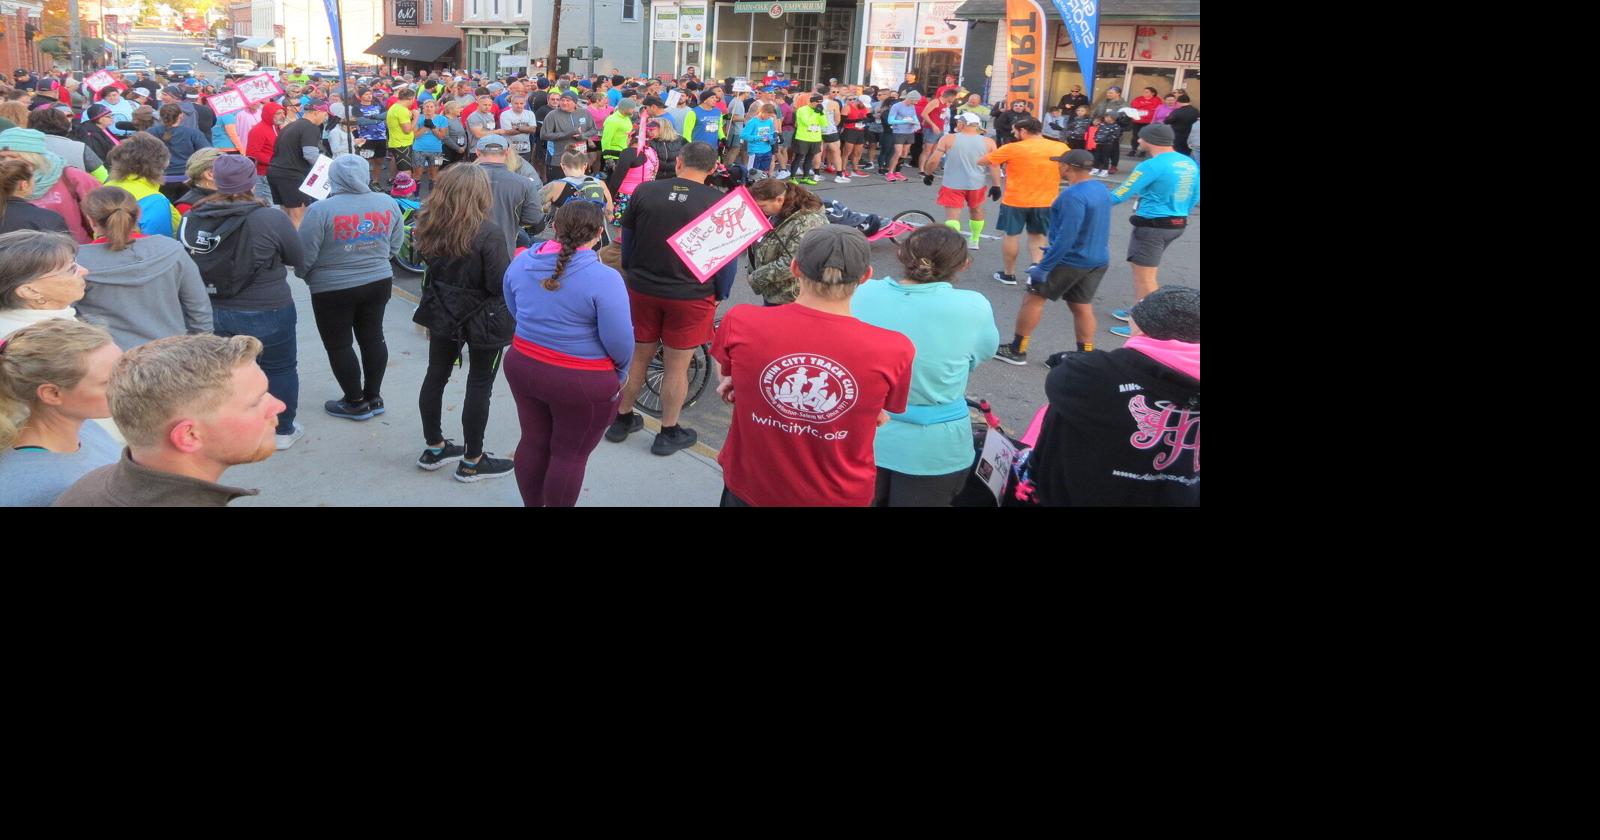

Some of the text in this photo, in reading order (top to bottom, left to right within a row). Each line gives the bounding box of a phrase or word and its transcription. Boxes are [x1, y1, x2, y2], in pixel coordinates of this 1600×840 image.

[679, 226, 702, 249] Team
[686, 225, 716, 256] Kylee
[763, 356, 855, 400] TWIN CITY TRACK CLUB
[751, 411, 848, 440] twincitytc.org
